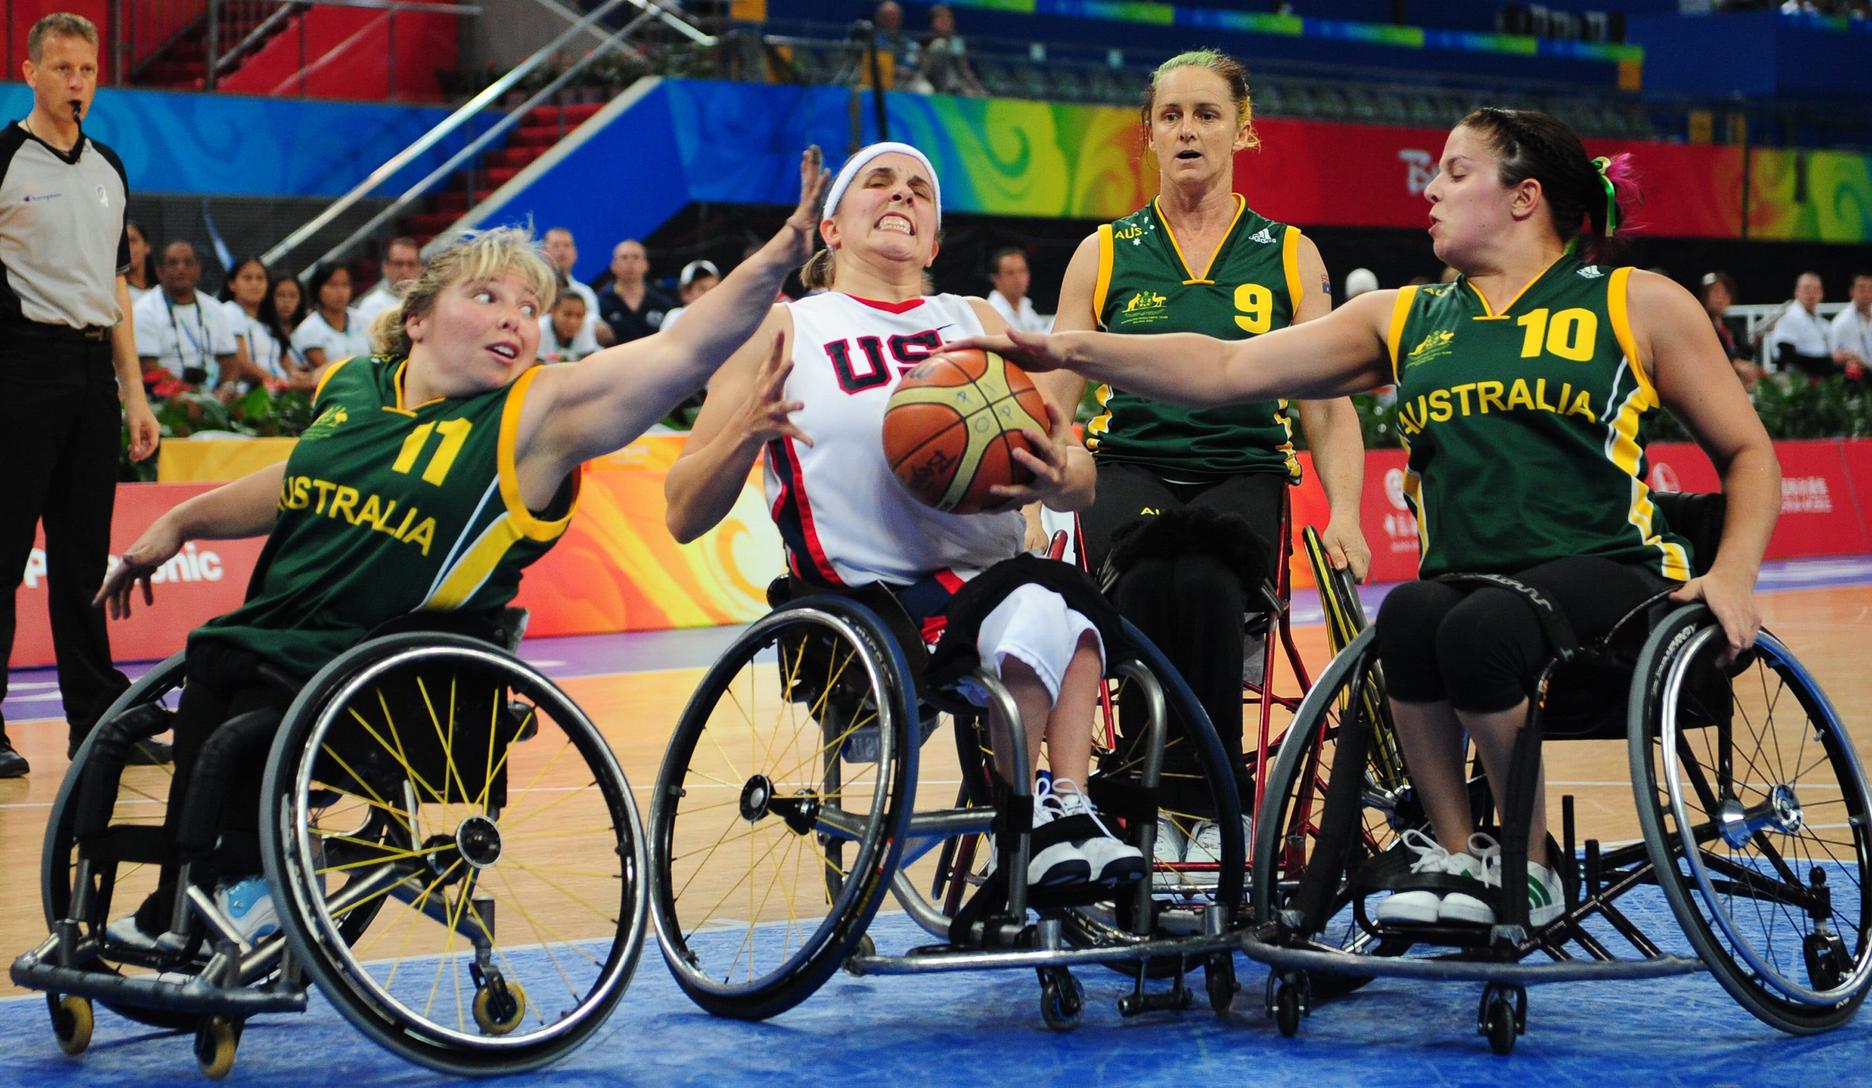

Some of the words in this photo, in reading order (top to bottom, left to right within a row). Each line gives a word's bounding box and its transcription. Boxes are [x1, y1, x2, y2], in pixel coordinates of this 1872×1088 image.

[1114, 227, 1143, 240] AUS
[1234, 283, 1273, 334] 9
[1517, 307, 1598, 362] 10
[823, 329, 944, 396] US
[1398, 378, 1596, 435] AUSTRALIA
[391, 416, 473, 488] 11
